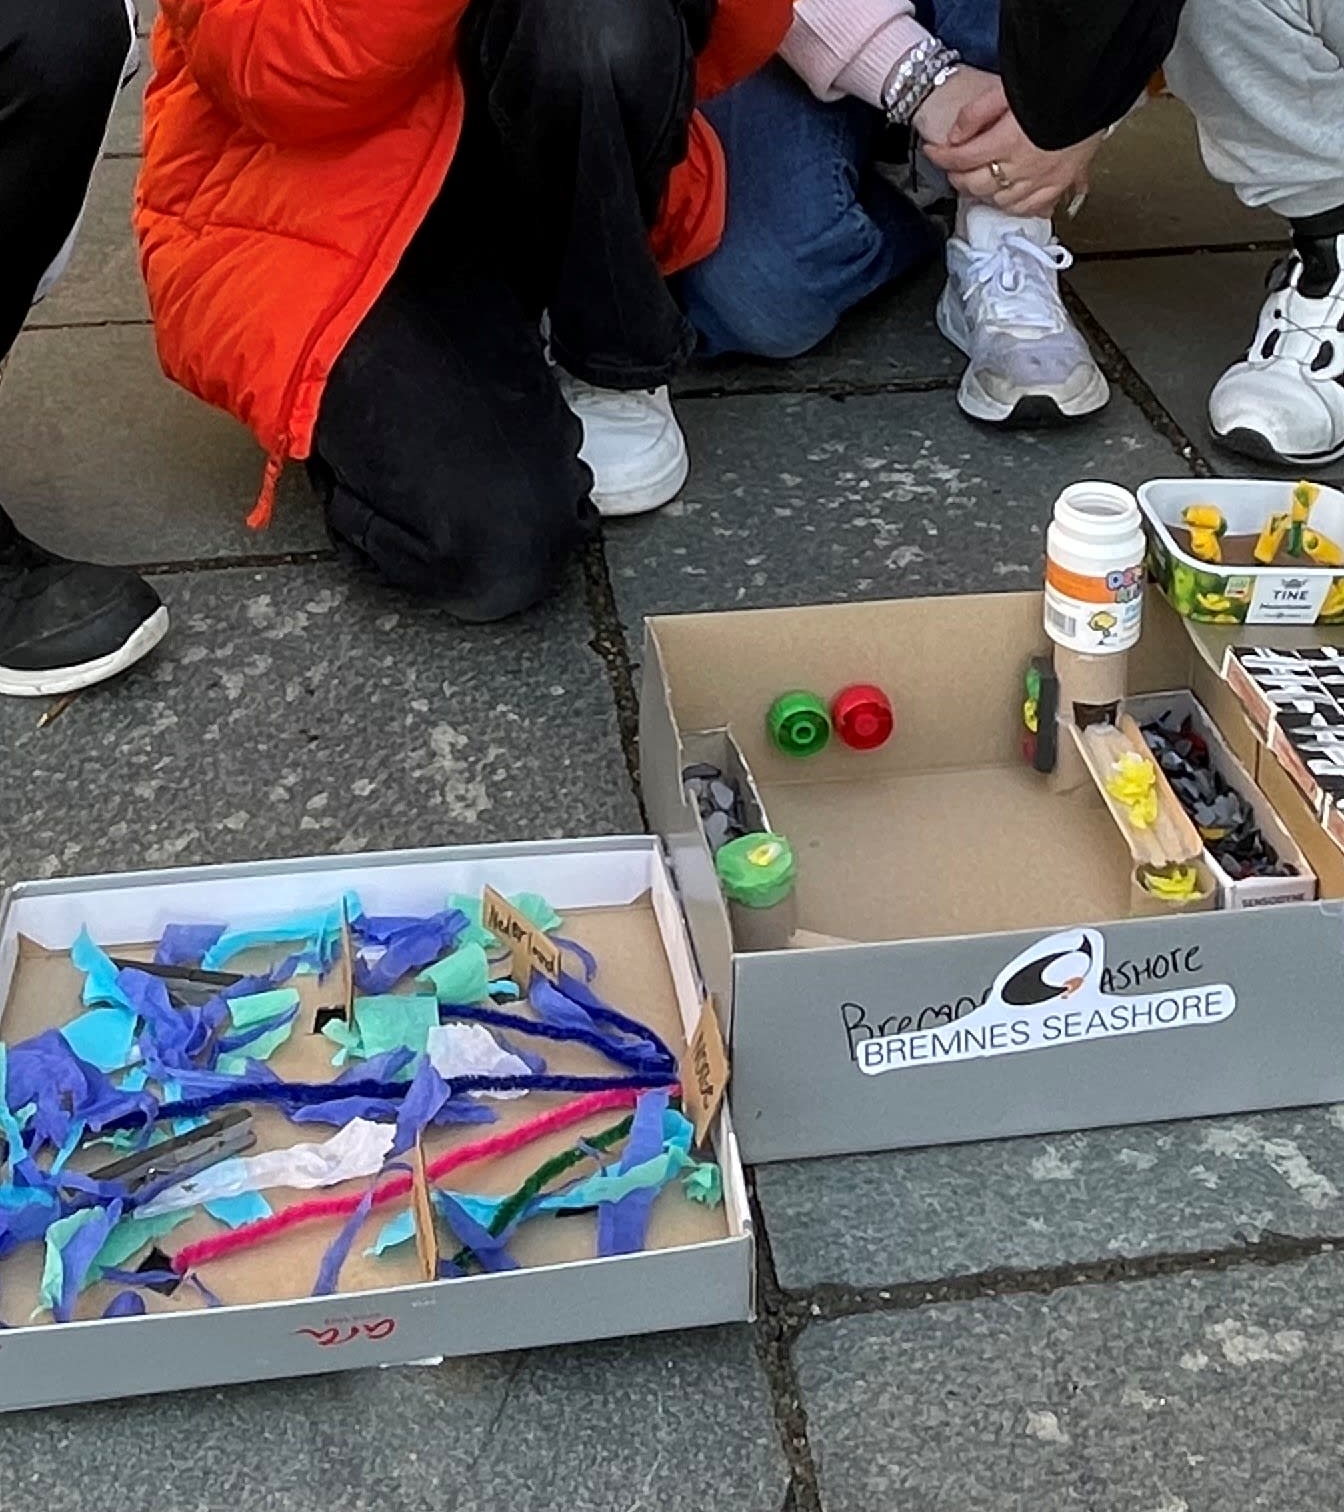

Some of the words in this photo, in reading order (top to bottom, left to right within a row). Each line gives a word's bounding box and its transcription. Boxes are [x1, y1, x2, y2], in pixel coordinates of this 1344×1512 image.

[1272, 590, 1310, 601] TINE
[863, 1020, 1031, 1068] BREMNES
[1042, 990, 1224, 1041] SEASHORE
[293, 1318, 396, 1347] ara
